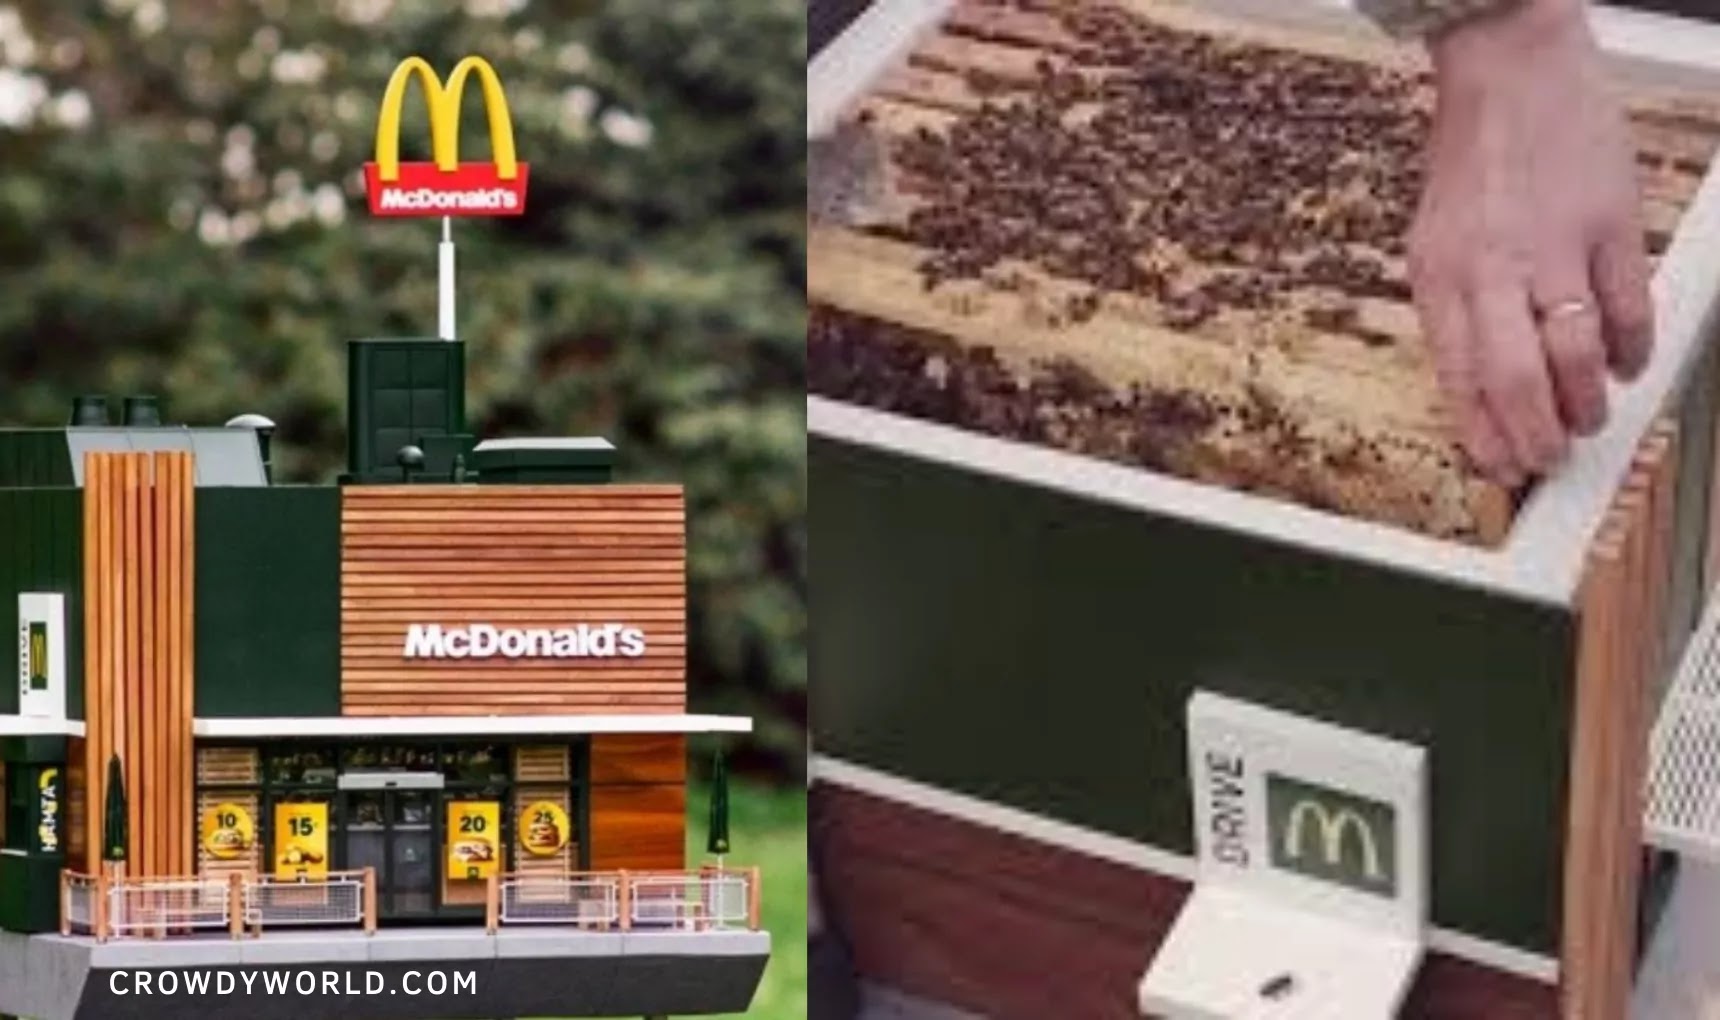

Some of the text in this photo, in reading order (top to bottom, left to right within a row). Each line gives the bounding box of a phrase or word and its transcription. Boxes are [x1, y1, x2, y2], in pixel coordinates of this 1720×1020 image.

[375, 56, 518, 181] M
[380, 188, 518, 209] McDonald's
[404, 623, 646, 657] McDonald's
[216, 812, 236, 829] 10
[460, 815, 486, 834] 20
[1205, 751, 1250, 868] DRIVE
[1285, 800, 1379, 876] M
